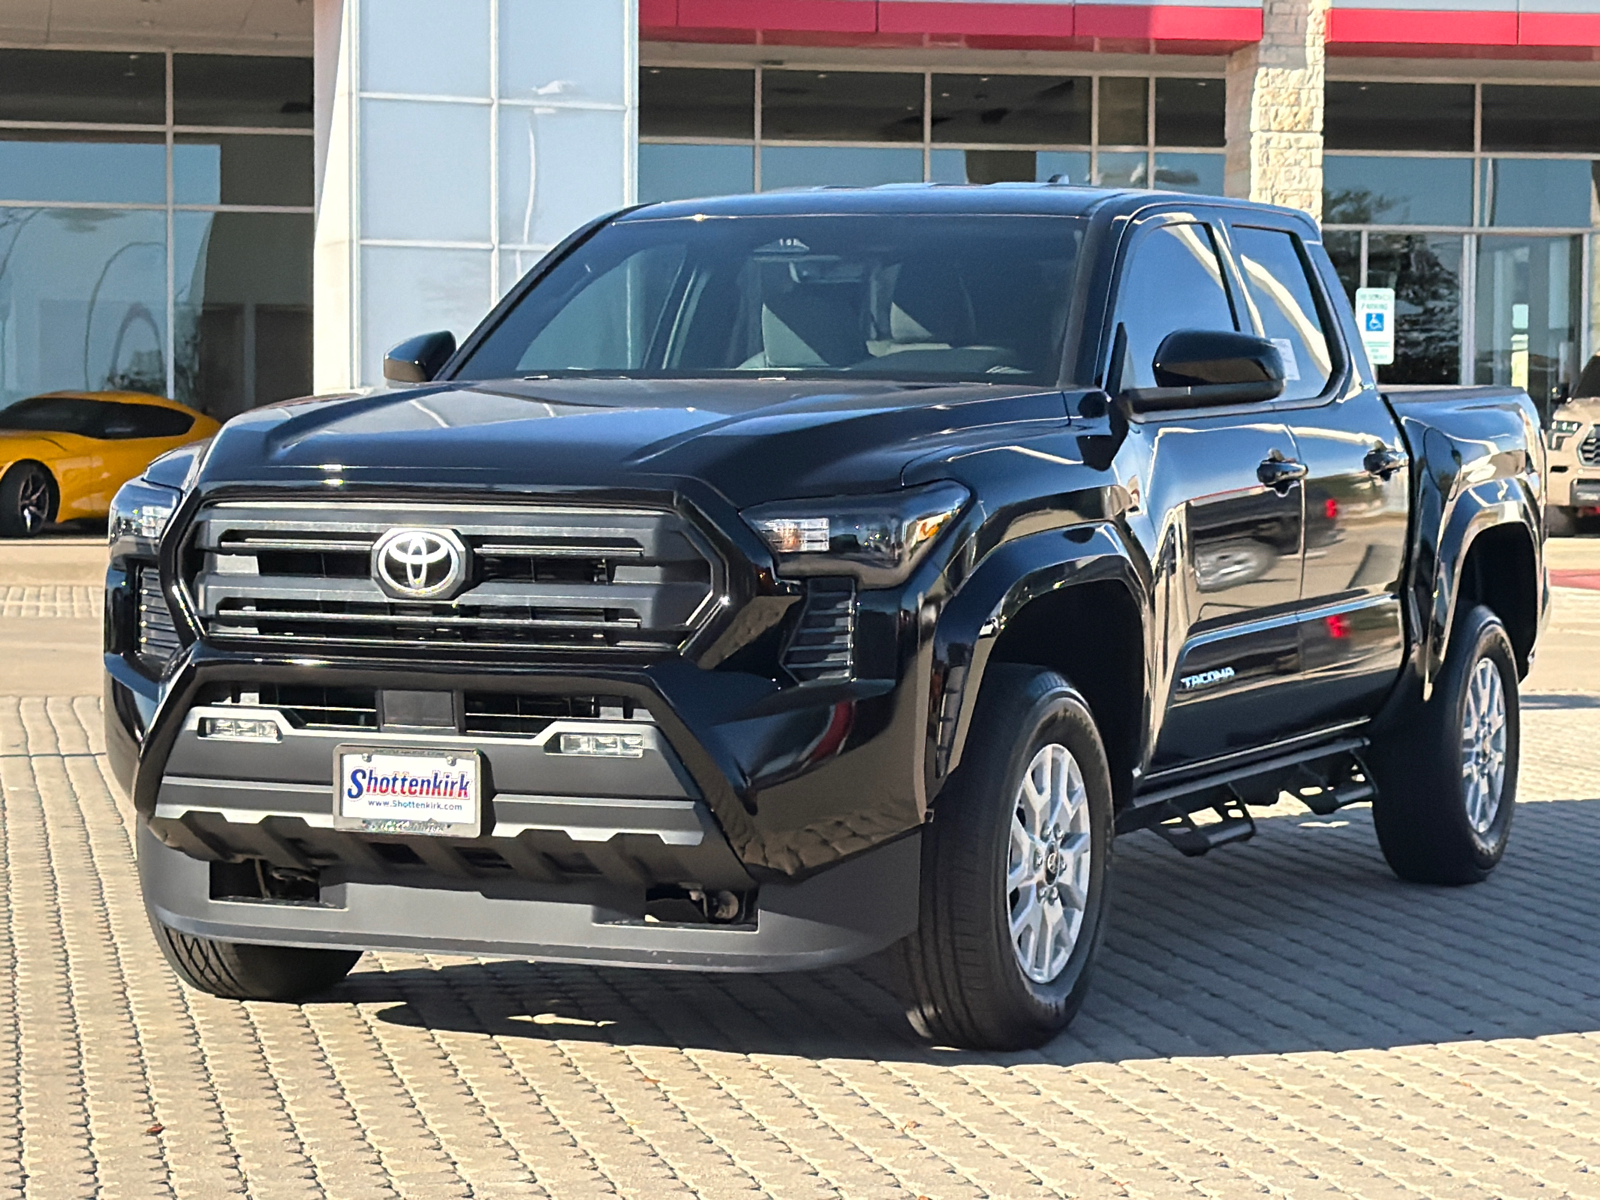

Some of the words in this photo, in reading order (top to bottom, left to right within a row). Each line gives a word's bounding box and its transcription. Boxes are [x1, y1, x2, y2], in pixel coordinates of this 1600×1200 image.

[1180, 666, 1235, 689] TACOMA
[347, 768, 470, 799] Shottenkirk
[368, 799, 463, 811] www.Shottenkirk.com
